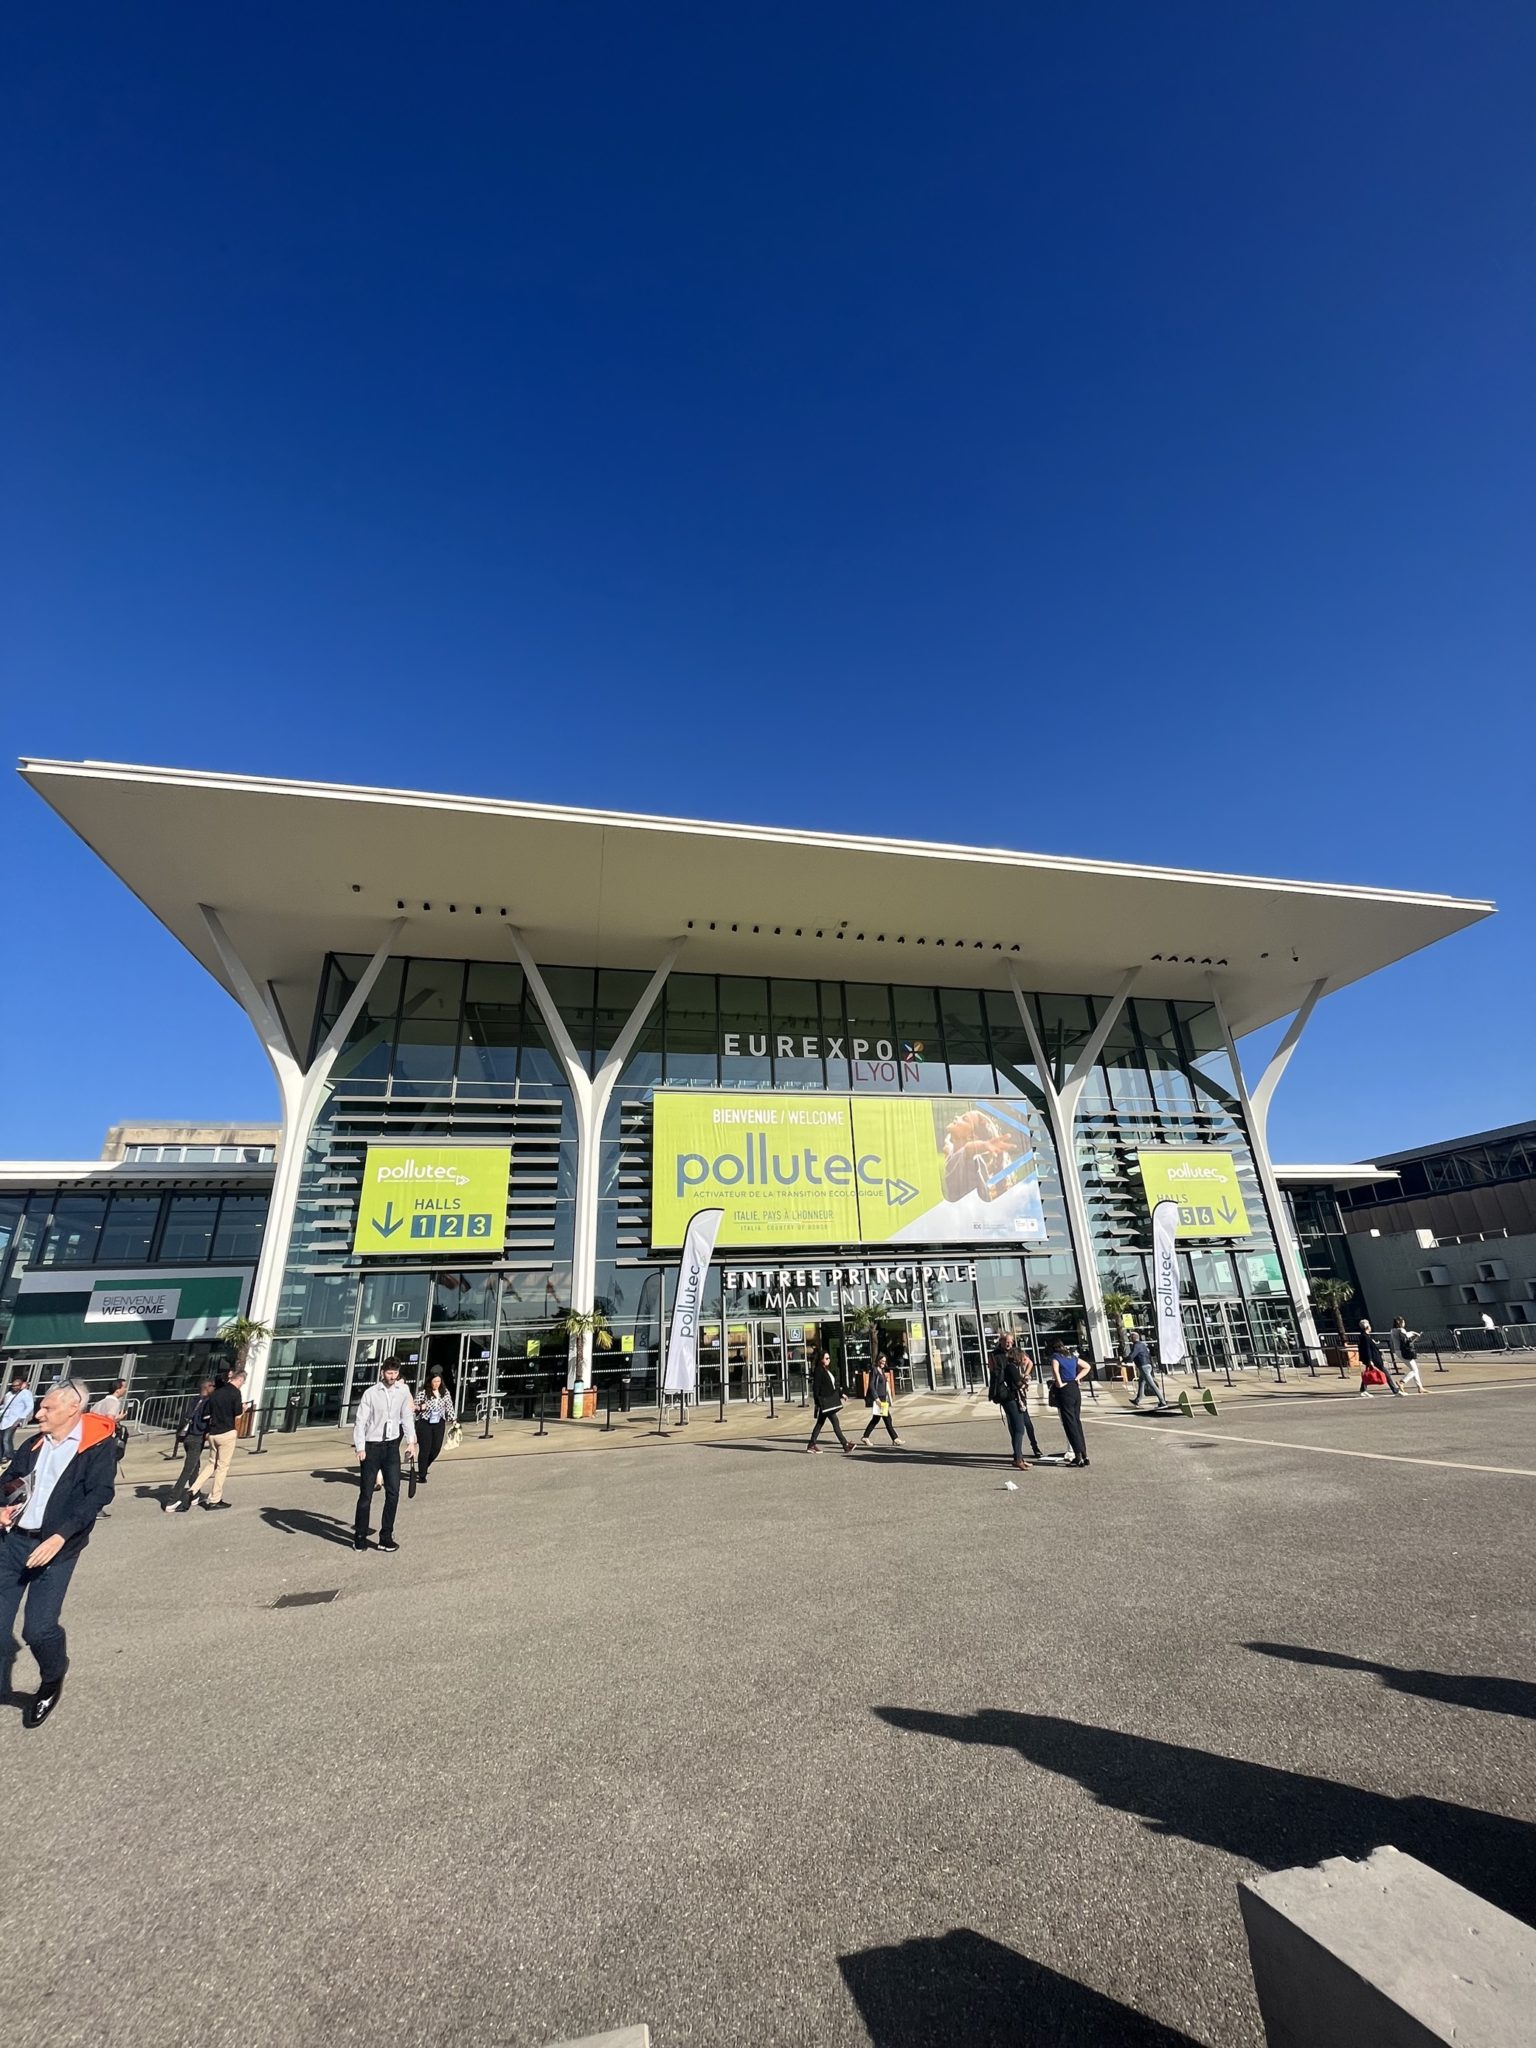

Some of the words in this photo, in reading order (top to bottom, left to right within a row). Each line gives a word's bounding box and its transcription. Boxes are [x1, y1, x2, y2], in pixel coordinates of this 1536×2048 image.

[724, 1033, 893, 1061] EUREXPO
[854, 1063, 920, 1083] LYON
[713, 1108, 777, 1124] BIENVENUE
[788, 1111, 844, 1125] WELCOME
[377, 1159, 457, 1183] pollutec
[676, 1132, 884, 1198] pollutec
[1167, 1162, 1218, 1181] pollutec
[414, 1198, 461, 1210] HALLS
[693, 1190, 747, 1198] ACTIVATEUR
[749, 1190, 762, 1198] DE
[763, 1190, 774, 1198] LA
[776, 1190, 826, 1198] TRANSITION
[763, 1210, 782, 1220] PAYS
[1183, 1209, 1192, 1224] 5
[1201, 1209, 1210, 1224] 6
[419, 1217, 428, 1236] 1
[444, 1217, 457, 1235] 2
[473, 1216, 486, 1235] 3
[833, 1265, 978, 1286] PRINCIPALE
[1157, 1251, 1176, 1318] pollutec
[103, 1295, 167, 1306] BIENVENUE
[677, 1265, 700, 1339] pollutec
[765, 1292, 820, 1309] MAIN
[831, 1287, 933, 1306] ENTRANCE
[102, 1304, 165, 1315] WELCOME
